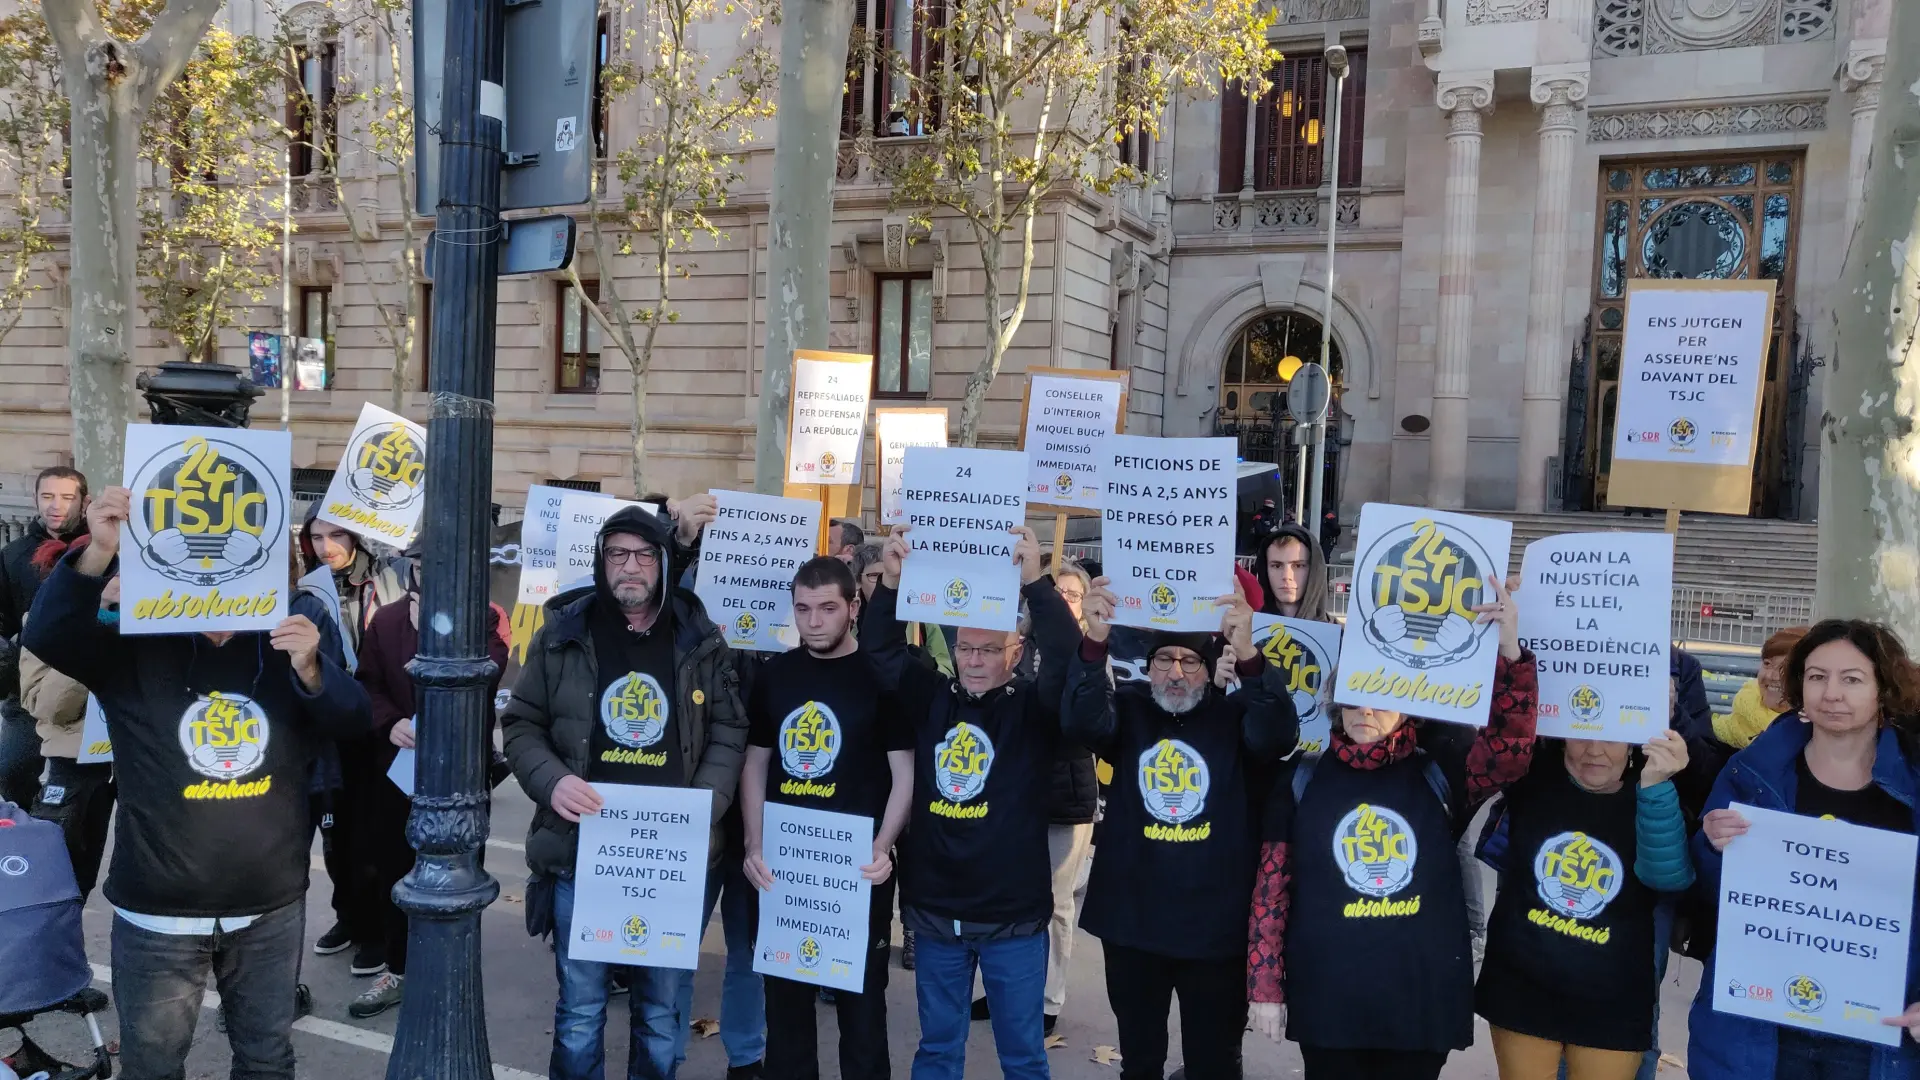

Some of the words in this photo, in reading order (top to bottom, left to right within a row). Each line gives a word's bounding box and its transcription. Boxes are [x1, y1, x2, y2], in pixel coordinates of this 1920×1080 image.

[1648, 317, 1677, 328] ENS
[1681, 318, 1742, 329] JUTGEN
[1678, 336, 1707, 346] PER
[1644, 354, 1738, 366] ASSEURE'NS
[1641, 372, 1704, 384] DAVANT
[1708, 374, 1738, 384] DEL
[798, 391, 864, 402] REPRESALIADES
[1046, 390, 1103, 401] CONSELLER
[1669, 390, 1705, 401] TSJC
[800, 409, 815, 417] PER
[818, 410, 860, 419] DEFENSAR
[1044, 407, 1100, 419] D'INTERIOR
[814, 425, 858, 435] REPÚBLICA
[1036, 424, 1074, 435] MIQUEL
[1077, 428, 1104, 437] BUCH
[1642, 432, 1660, 440] CDR
[381, 422, 414, 462] 24
[1046, 443, 1091, 454] DIMISSIÓ
[175, 436, 237, 501] 24
[356, 442, 425, 486] TSJC
[1037, 460, 1096, 472] IMMEDIATA!
[1114, 455, 1194, 471] PETICIONS
[1199, 459, 1221, 471] DE
[956, 467, 972, 478] 24
[906, 490, 1020, 506] REPRESALIADES
[1108, 482, 1137, 496] FINS
[1142, 486, 1152, 497] A
[1157, 486, 1178, 501] 2,5
[1183, 487, 1228, 499] ANYS
[144, 489, 265, 535] TSJC
[327, 501, 409, 537] absolució
[573, 514, 593, 524] ENS
[719, 508, 786, 524] PETICIONS
[790, 515, 807, 525] DE
[1107, 509, 1123, 522] DE
[1127, 511, 1177, 526] PRESÓ
[1182, 515, 1213, 527] PER
[1218, 515, 1229, 526] A
[546, 522, 557, 532] ÉS
[910, 515, 935, 527] PER
[939, 517, 1014, 531] DEFENSAR
[709, 530, 738, 540] FINS
[742, 533, 750, 542] A
[754, 534, 771, 546] 2,5
[775, 536, 809, 548] ANYS
[1117, 538, 1132, 550] 14
[1137, 540, 1215, 555] MEMBRES
[912, 540, 928, 551] LA
[933, 540, 1010, 557] REPÚBLICA
[1403, 519, 1459, 583] 24
[532, 558, 543, 567] ÉS
[705, 552, 721, 562] DE
[726, 554, 767, 566] PRESÓ
[771, 558, 794, 569] PER
[1550, 551, 1601, 565] QUAN
[1608, 552, 1631, 564] LA
[1132, 566, 1160, 579] DEL
[1165, 569, 1197, 581] CDR
[1540, 570, 1640, 586] INJUSTÍCIA
[713, 575, 726, 584] 14
[730, 577, 792, 591] MEMBRES
[920, 593, 936, 602] CDR
[1125, 596, 1141, 606] CDR
[1375, 565, 1483, 621] TSJC
[1555, 592, 1575, 608] ÉS
[1581, 595, 1623, 611] LLEI,
[133, 588, 278, 620] absolució
[722, 598, 746, 608] DEL
[750, 600, 776, 611] CDR
[1576, 617, 1599, 630] LA
[1262, 622, 1302, 670] 24
[1518, 637, 1660, 655] DESOBEDIÈNCIA
[1552, 661, 1577, 674] UN
[1584, 662, 1650, 677] DEURE!
[623, 671, 650, 703] 24
[1347, 666, 1483, 709] absolució
[205, 691, 240, 728] 24
[609, 696, 661, 720] TSJC
[797, 700, 824, 734] 24
[1539, 704, 1559, 714] CDR
[189, 719, 259, 746] TSJC
[785, 728, 834, 752] TSJC
[951, 722, 976, 756] 24
[601, 747, 667, 767] absolució
[939, 749, 988, 775] TSJC
[1156, 739, 1183, 774] 24
[183, 775, 271, 799] absolució
[780, 778, 836, 798] absolució
[1144, 766, 1201, 792] TSJC
[600, 808, 628, 820] ENS
[632, 811, 689, 824] JUTGEN
[930, 799, 988, 818] absolució
[1144, 822, 1211, 842] absolució
[1356, 803, 1388, 843] 24
[630, 828, 658, 840] PER
[780, 822, 853, 843] CONSELLER
[598, 845, 687, 862] ASSEURE'NS
[779, 846, 852, 866] D'INTERIOR
[1341, 833, 1408, 863] TSJC
[1564, 832, 1599, 870] 24
[1782, 840, 1850, 864] TOTES
[595, 865, 655, 879] DAVANT
[660, 870, 686, 882] DEL
[772, 869, 819, 886] MIQUEL
[823, 877, 858, 892] BUCH
[1545, 852, 1614, 895] TSJC
[1790, 871, 1838, 890] SOM
[622, 886, 656, 899] TSJC
[785, 895, 841, 913] DIMISSIÓ
[1343, 896, 1420, 918] absolució
[1728, 890, 1901, 933] REPRESALIADES
[596, 928, 613, 939] CDR
[776, 916, 850, 940] IMMEDIATA!
[1527, 907, 1611, 944] absolució
[1744, 923, 1877, 959] POLÍTIQUES!
[776, 951, 790, 960] CDR
[1749, 985, 1773, 997] CDR
